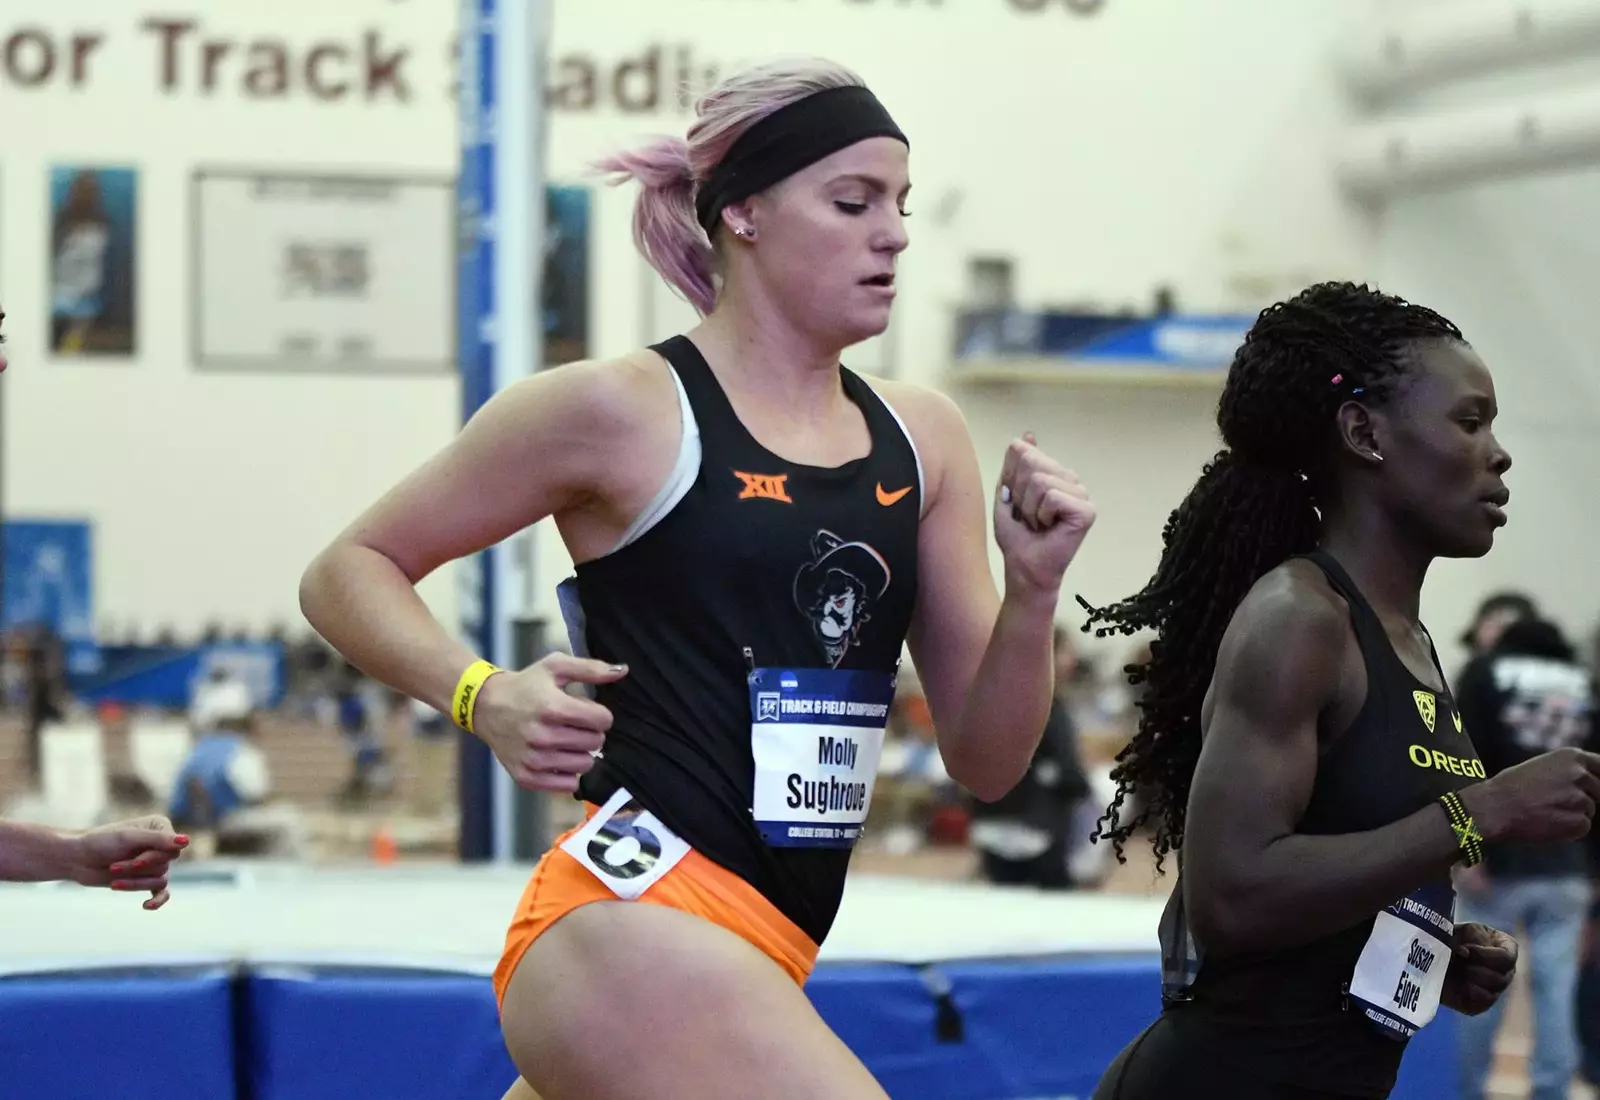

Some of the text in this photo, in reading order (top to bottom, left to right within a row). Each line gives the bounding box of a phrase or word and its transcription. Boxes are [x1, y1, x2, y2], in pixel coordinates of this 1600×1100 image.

[139, 17, 411, 100] Track
[780, 699, 813, 714] TRACK
[822, 701, 847, 716] FIELD
[818, 736, 858, 770] Molly
[786, 773, 866, 814] Sughroue
[587, 798, 662, 880] 6
[1403, 897, 1428, 918] TRACK
[1407, 938, 1435, 973] Susan
[1393, 970, 1421, 1013] Ejore
